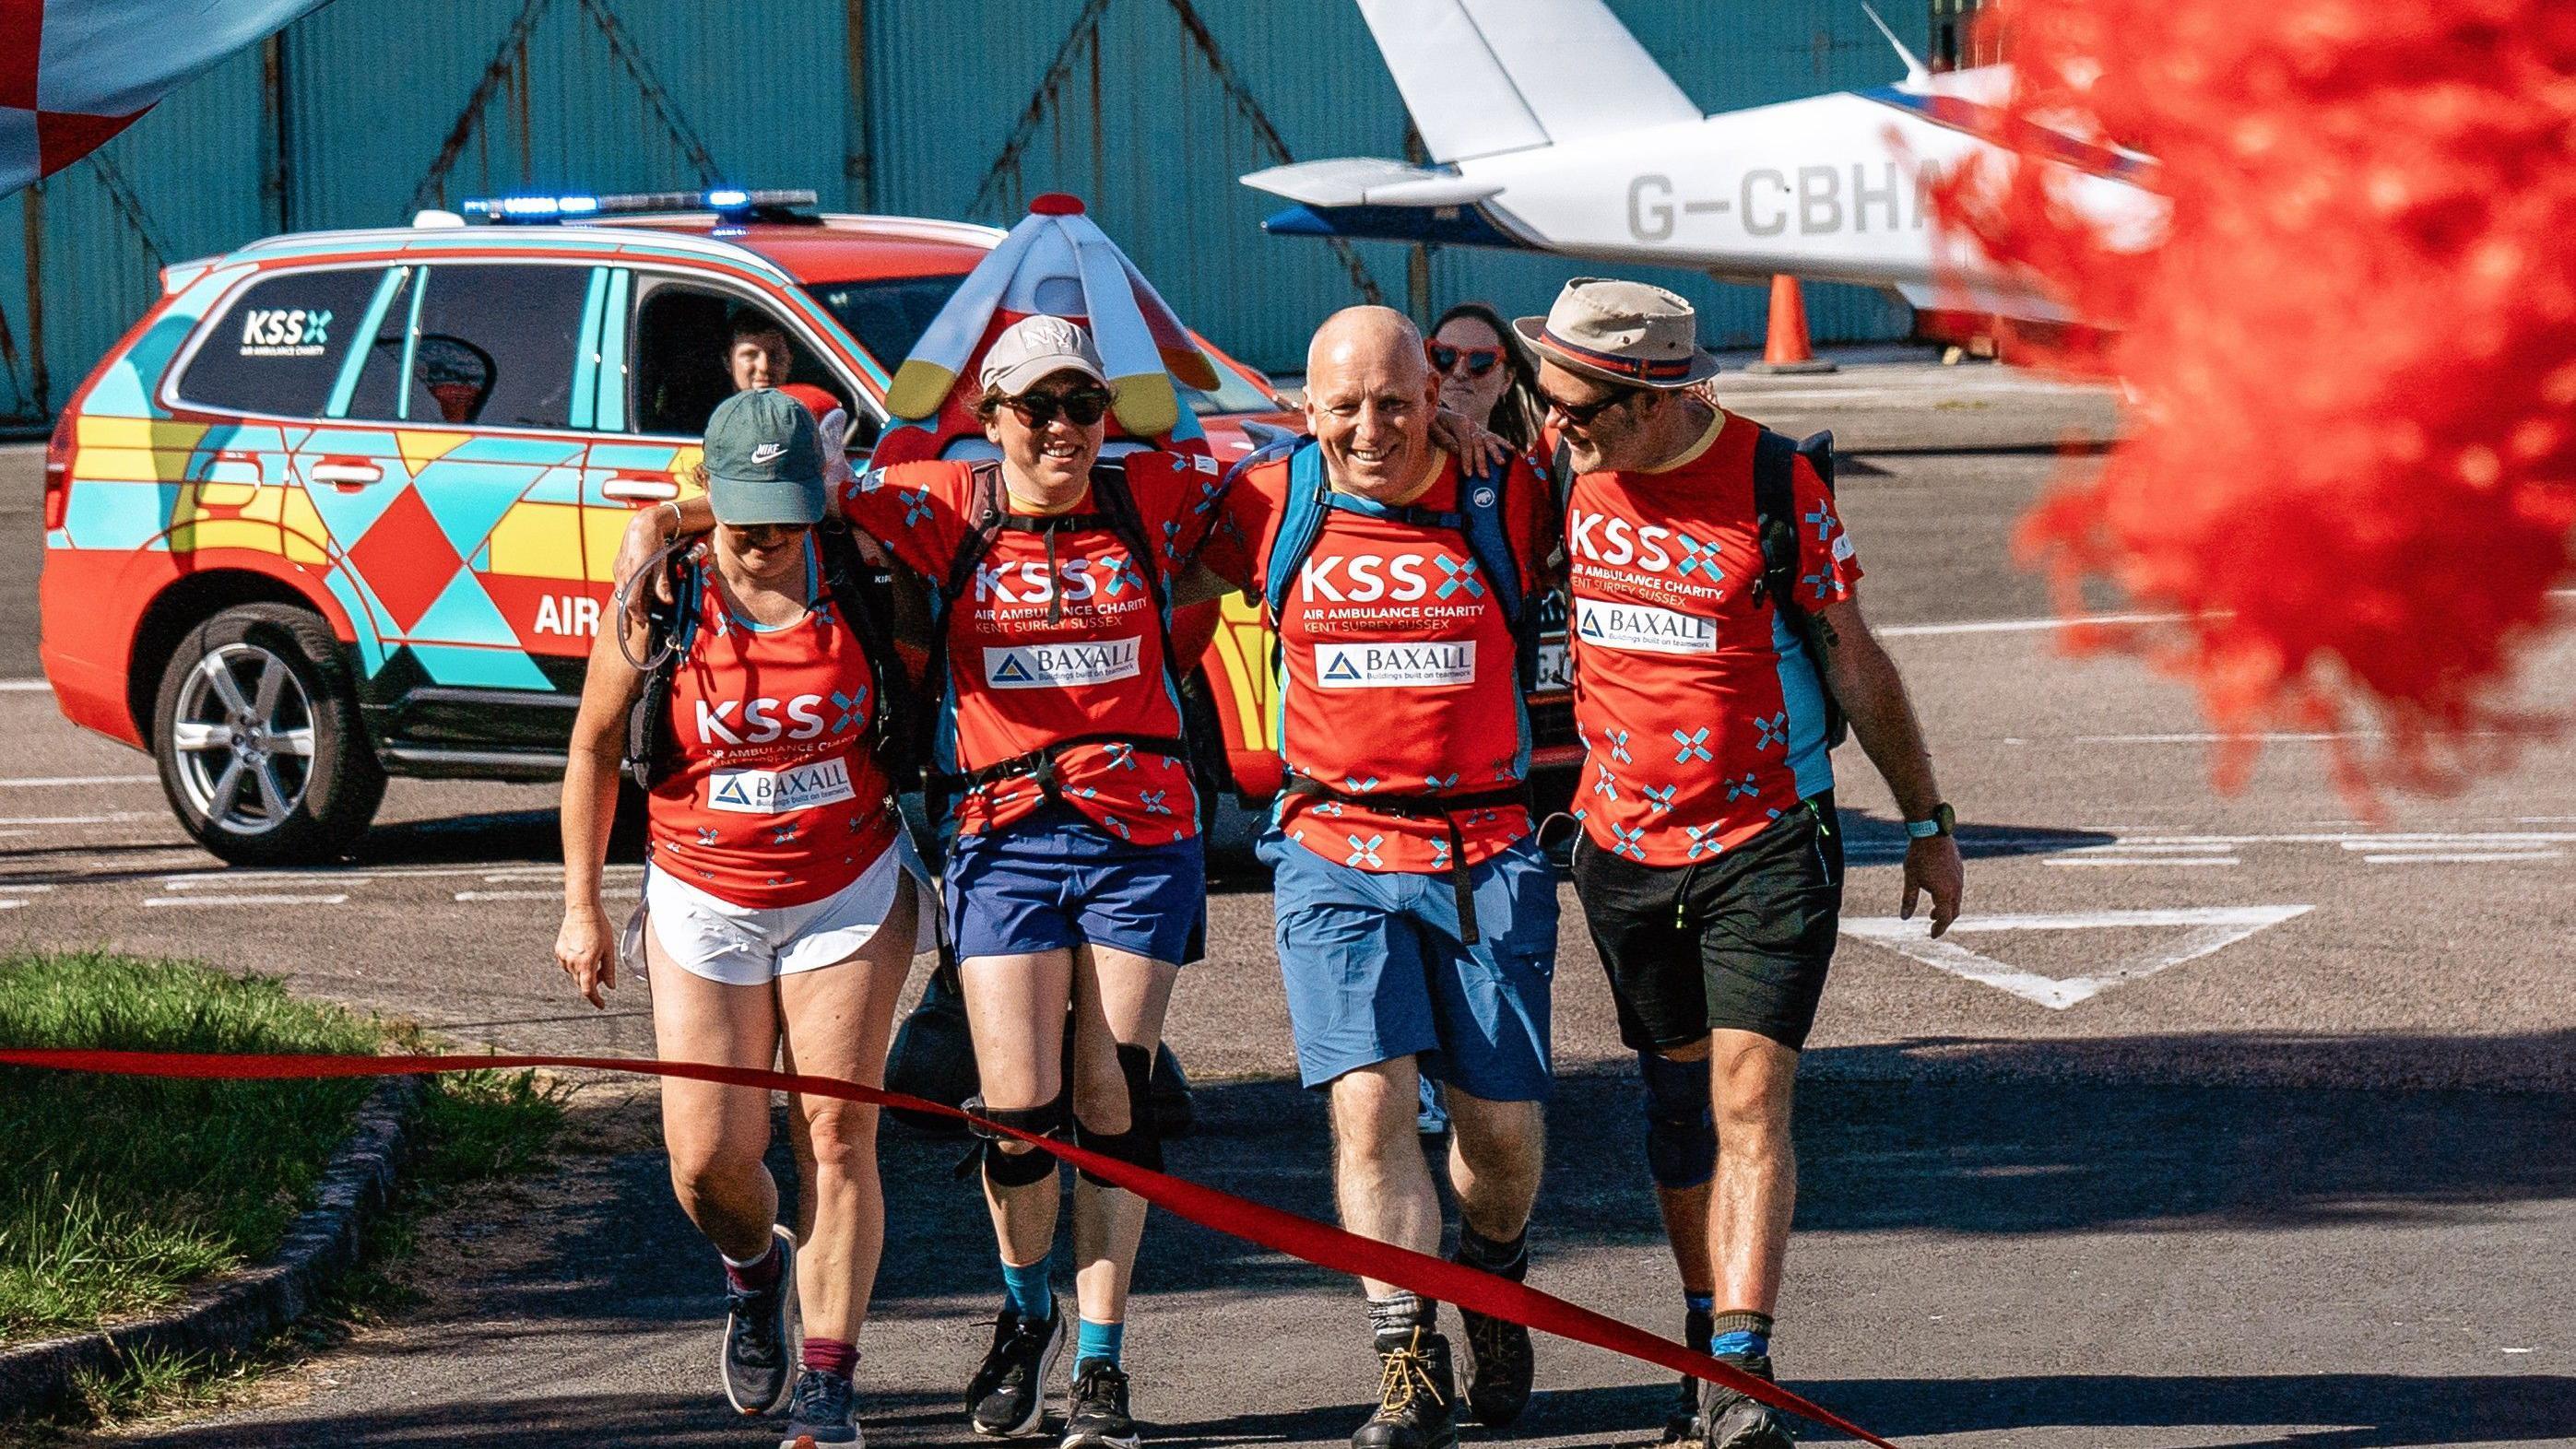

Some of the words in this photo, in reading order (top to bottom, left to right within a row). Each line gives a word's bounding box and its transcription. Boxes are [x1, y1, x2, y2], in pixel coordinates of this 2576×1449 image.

[756, 443, 780, 455] NIKE
[1569, 509, 1671, 572] KSS
[975, 559, 1097, 603] KSS
[1302, 554, 1427, 602] KSS
[1585, 565, 1661, 591] AMBULANCE
[1664, 581, 1724, 600] CHARITY
[975, 609, 996, 620] AIR
[1097, 596, 1147, 614] CHARITY
[1637, 587, 1687, 607] SUSSEX
[534, 595, 600, 637] AIR
[975, 622, 1009, 634] KENT
[1070, 616, 1122, 629] SUSSEX
[1303, 609, 1325, 620] AIR
[1328, 607, 1424, 619] AMBULANCE
[1424, 605, 1485, 618] CHARITY
[1304, 621, 1337, 633] KENT
[1398, 619, 1449, 630] SUSSEX
[1610, 609, 1711, 640] BAXALL
[1037, 643, 1134, 671] BAXALL
[1366, 646, 1471, 671] BAXALL
[695, 694, 824, 745] KSS
[729, 744, 814, 758] AMBULANCE
[757, 764, 847, 798] BAXALL
